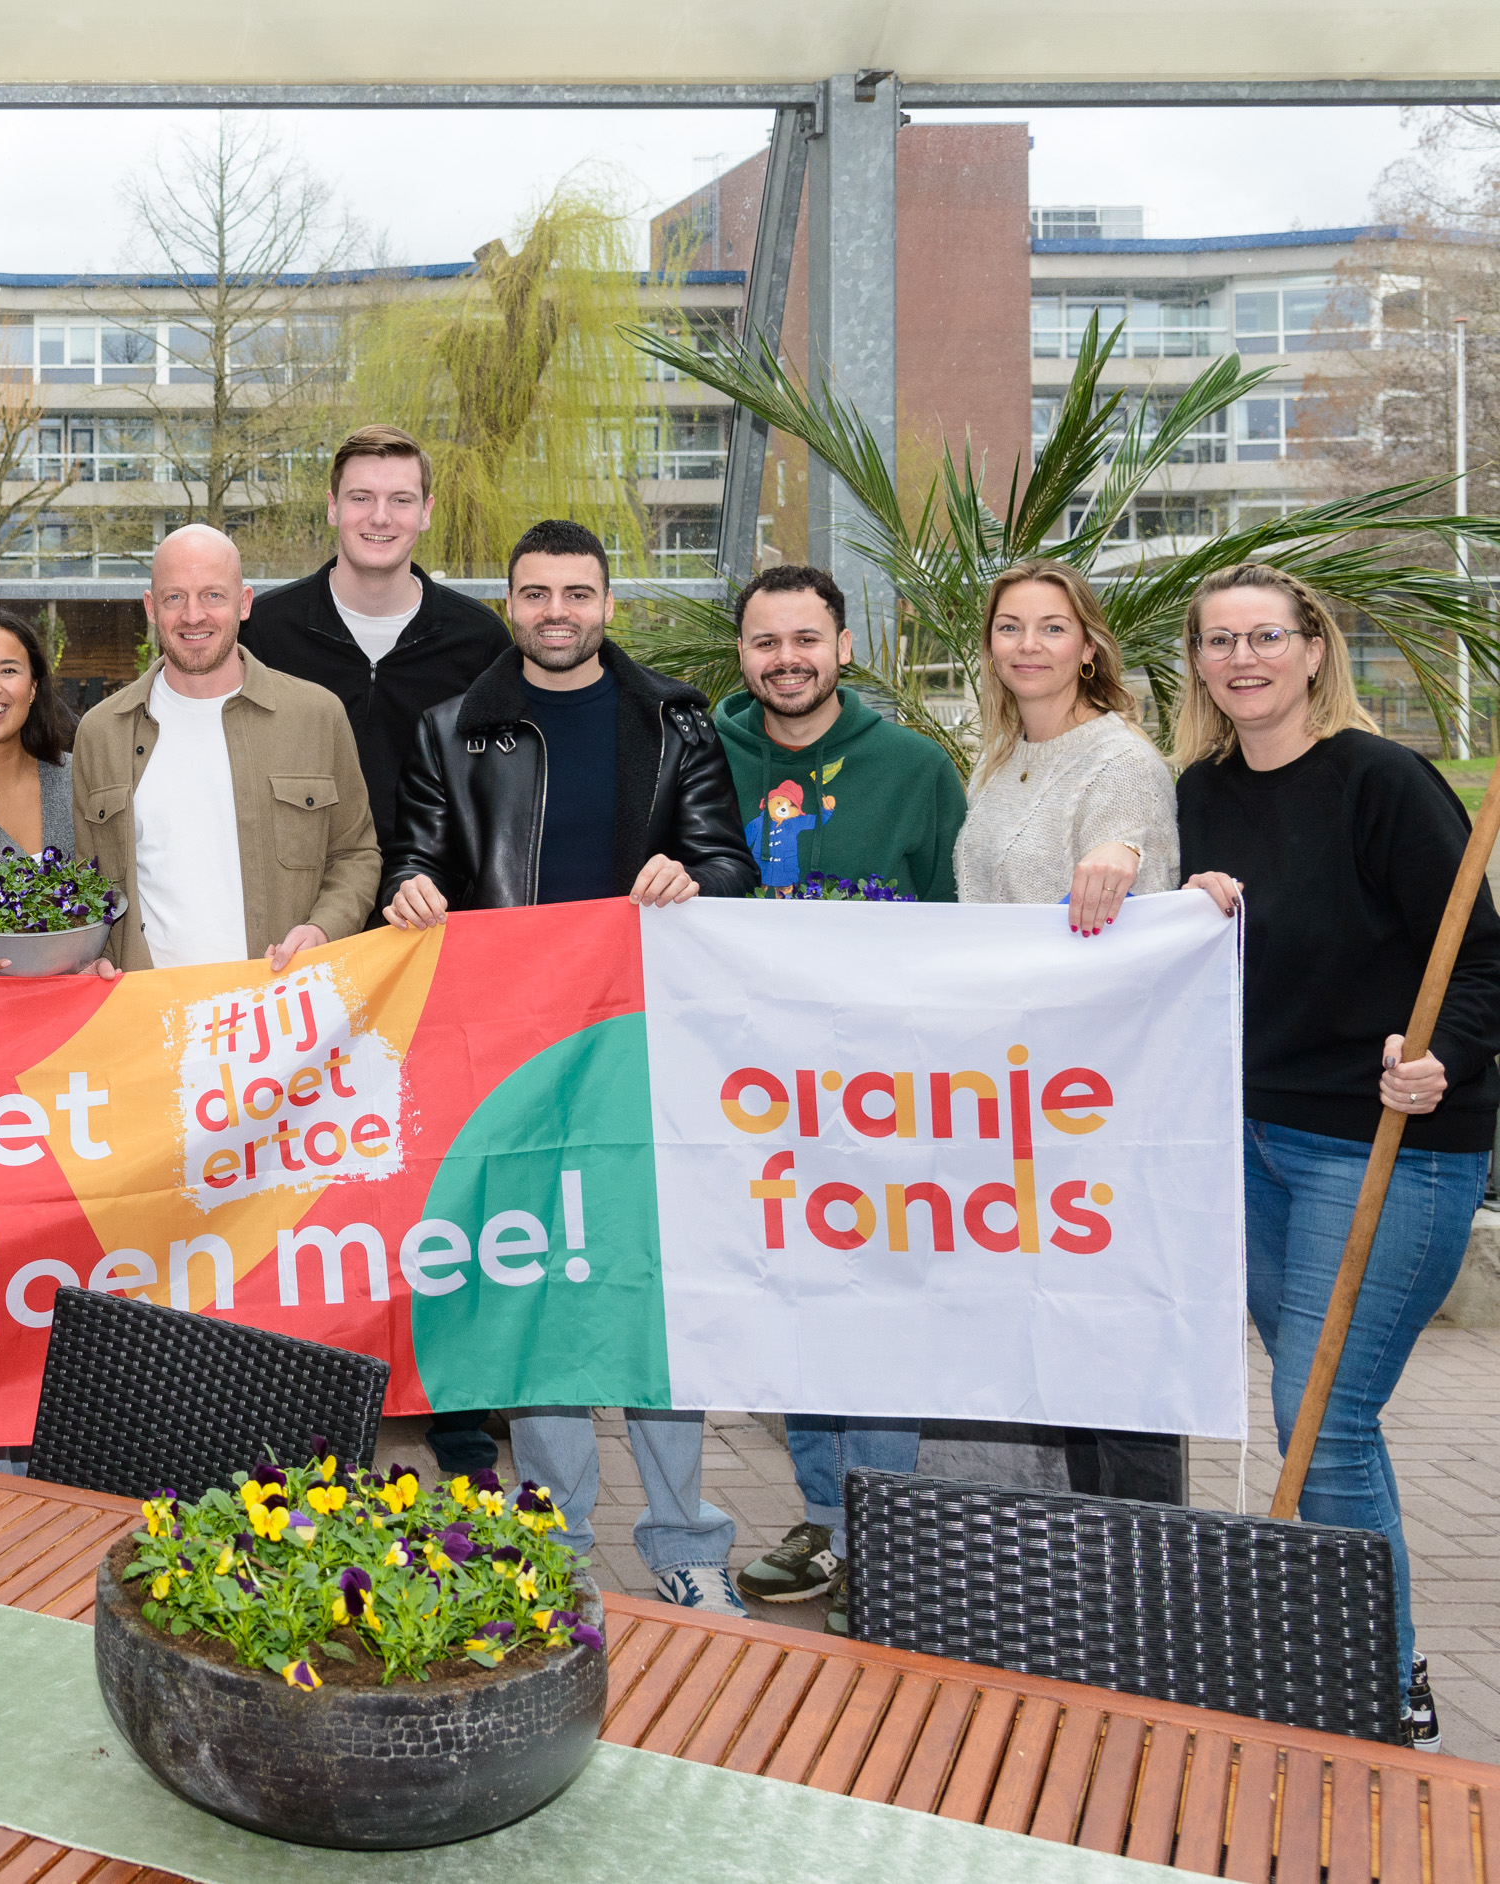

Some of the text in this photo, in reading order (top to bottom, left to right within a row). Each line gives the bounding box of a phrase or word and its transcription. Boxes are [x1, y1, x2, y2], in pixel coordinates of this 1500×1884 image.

[201, 977, 318, 1064] #jij
[196, 1046, 357, 1132] doet
[720, 1044, 1114, 1160] oranje
[203, 1114, 391, 1189] ertoe
[276, 1170, 592, 1307] mee!
[749, 1150, 1114, 1256] fonds
